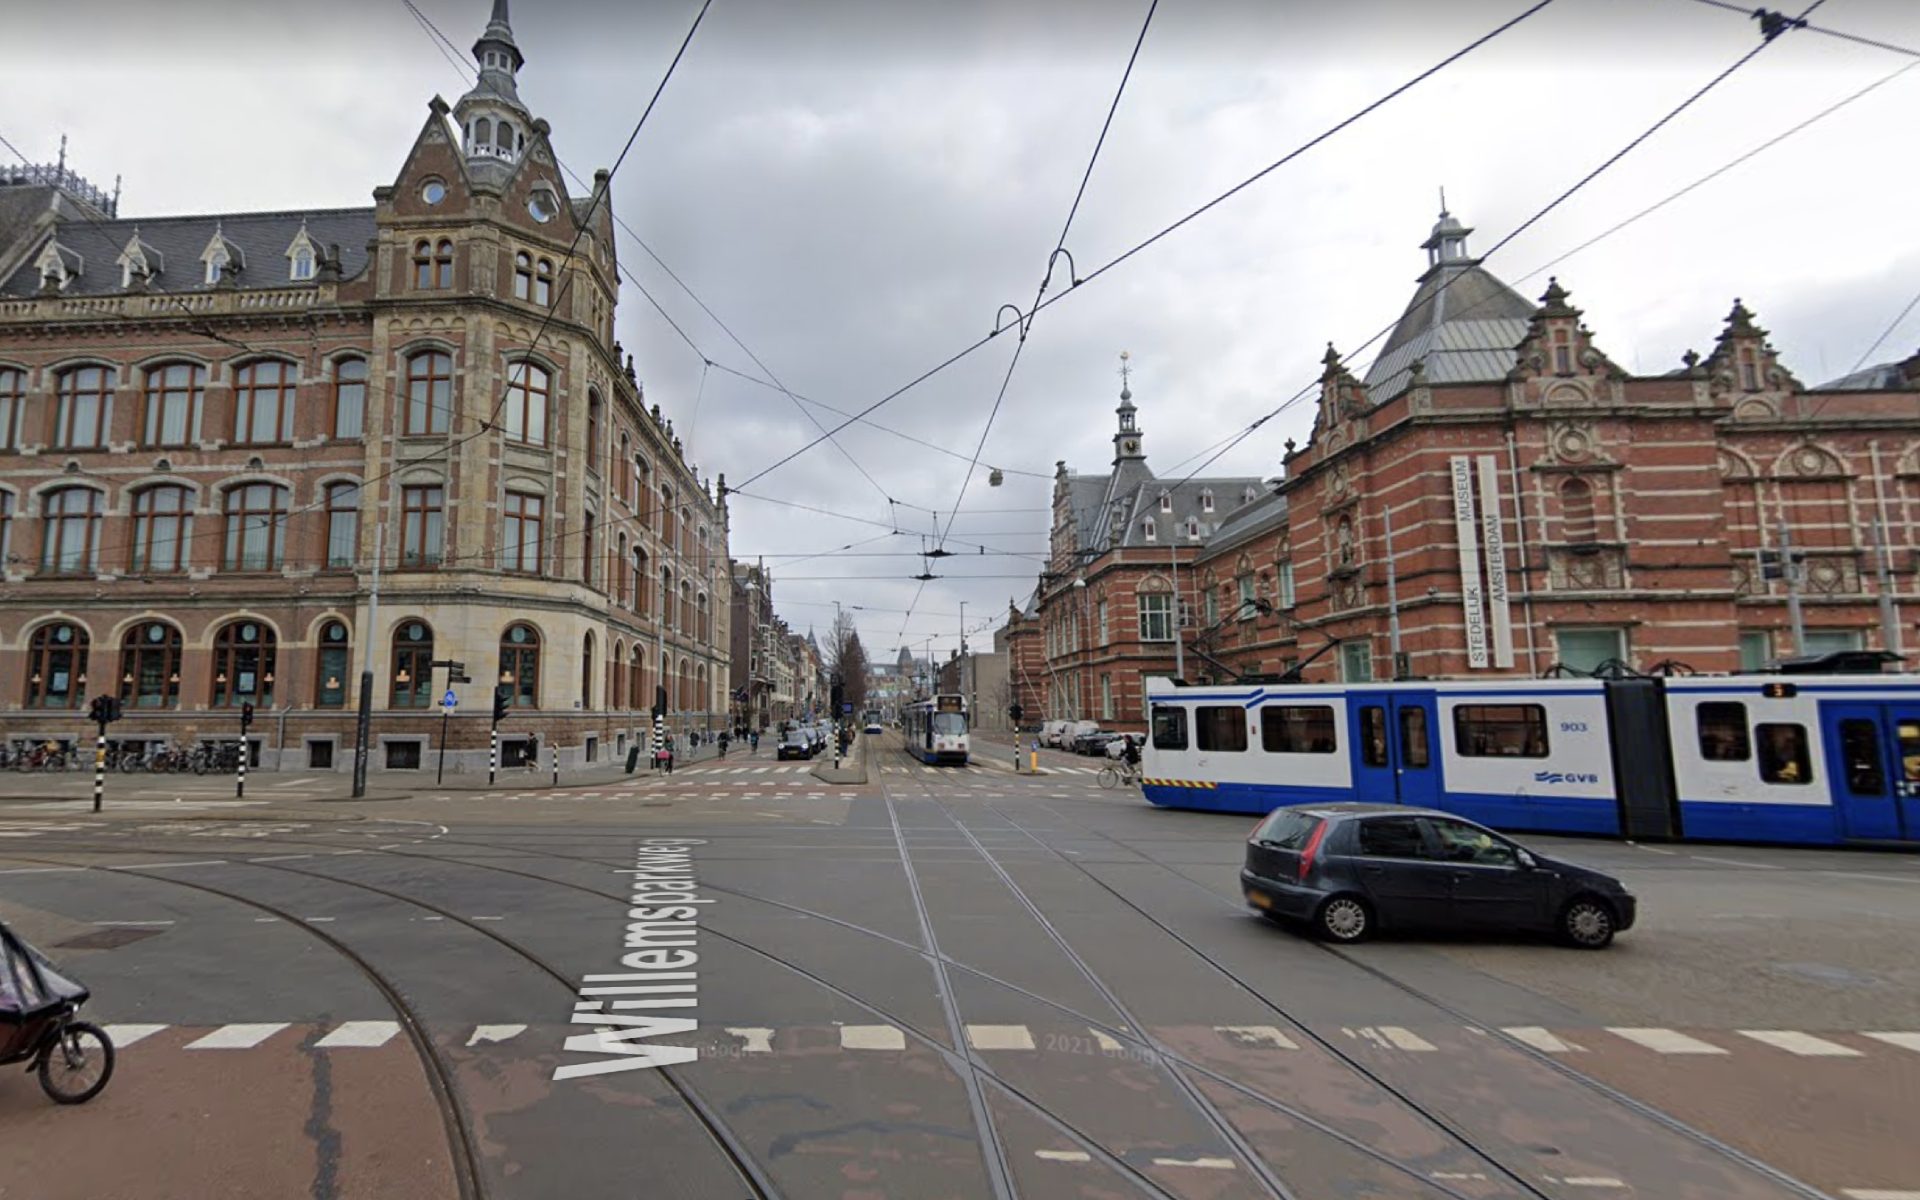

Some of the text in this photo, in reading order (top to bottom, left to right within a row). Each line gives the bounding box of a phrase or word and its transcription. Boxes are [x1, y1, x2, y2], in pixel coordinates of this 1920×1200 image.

[1455, 460, 1486, 662] STEDELIJK MUSEUM
[1485, 514, 1505, 602] AMSTERDAM
[1560, 722, 1588, 732] 903
[1565, 772, 1598, 783] GVB
